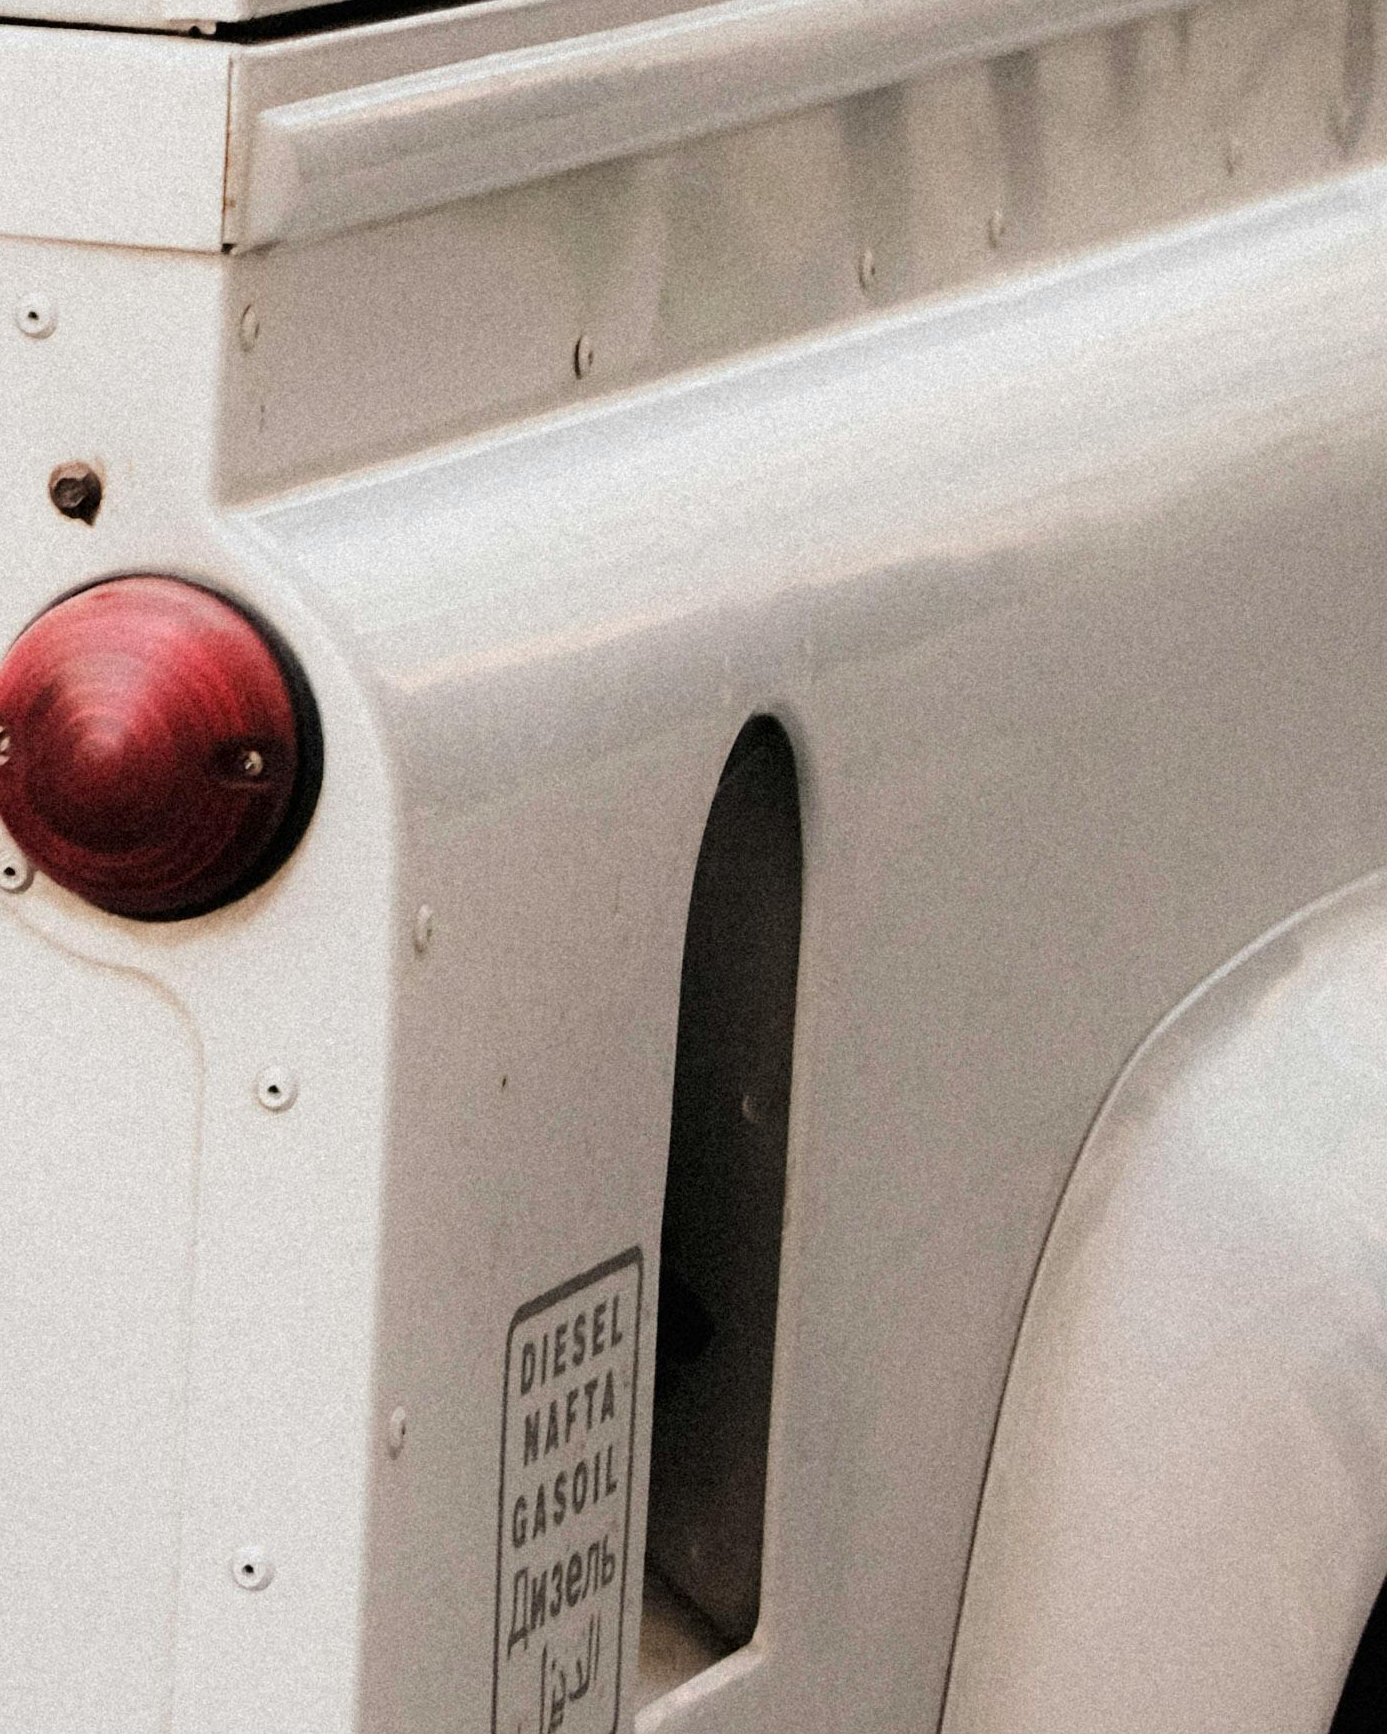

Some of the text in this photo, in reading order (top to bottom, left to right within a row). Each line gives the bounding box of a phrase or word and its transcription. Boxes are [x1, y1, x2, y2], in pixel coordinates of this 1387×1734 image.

[519, 1294, 624, 1397] DIESEL
[523, 1369, 616, 1467] NAFTA
[511, 1443, 618, 1550] GASOIL
[507, 1533, 617, 1660] Дизель
